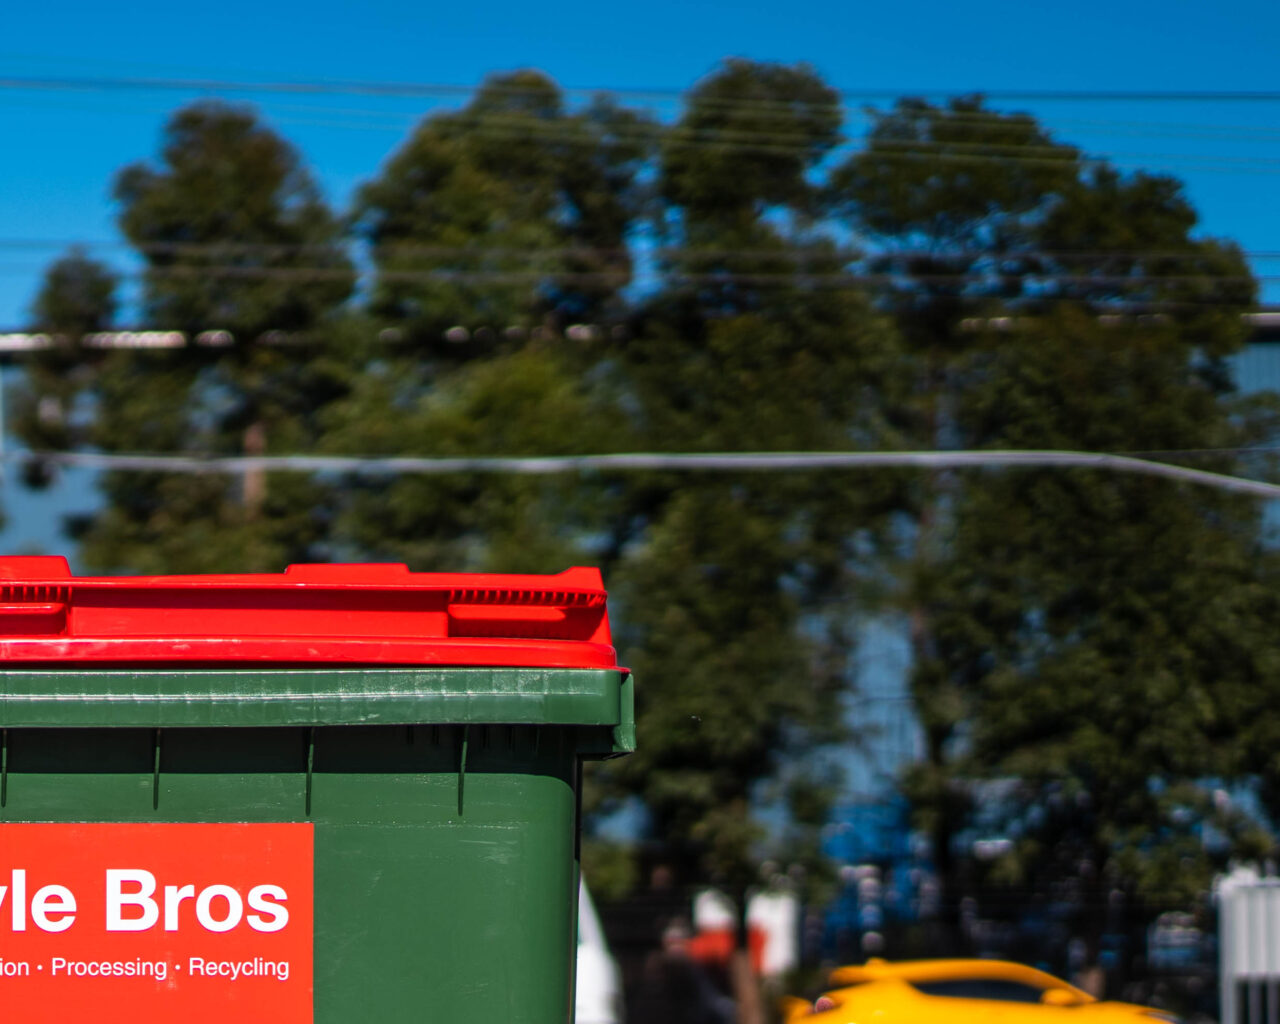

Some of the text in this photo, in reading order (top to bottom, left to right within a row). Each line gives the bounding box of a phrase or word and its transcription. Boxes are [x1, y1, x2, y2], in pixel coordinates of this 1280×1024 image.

[106, 869, 288, 932] Bros
[52, 958, 166, 980] Processing
[190, 958, 288, 980] Recycling
